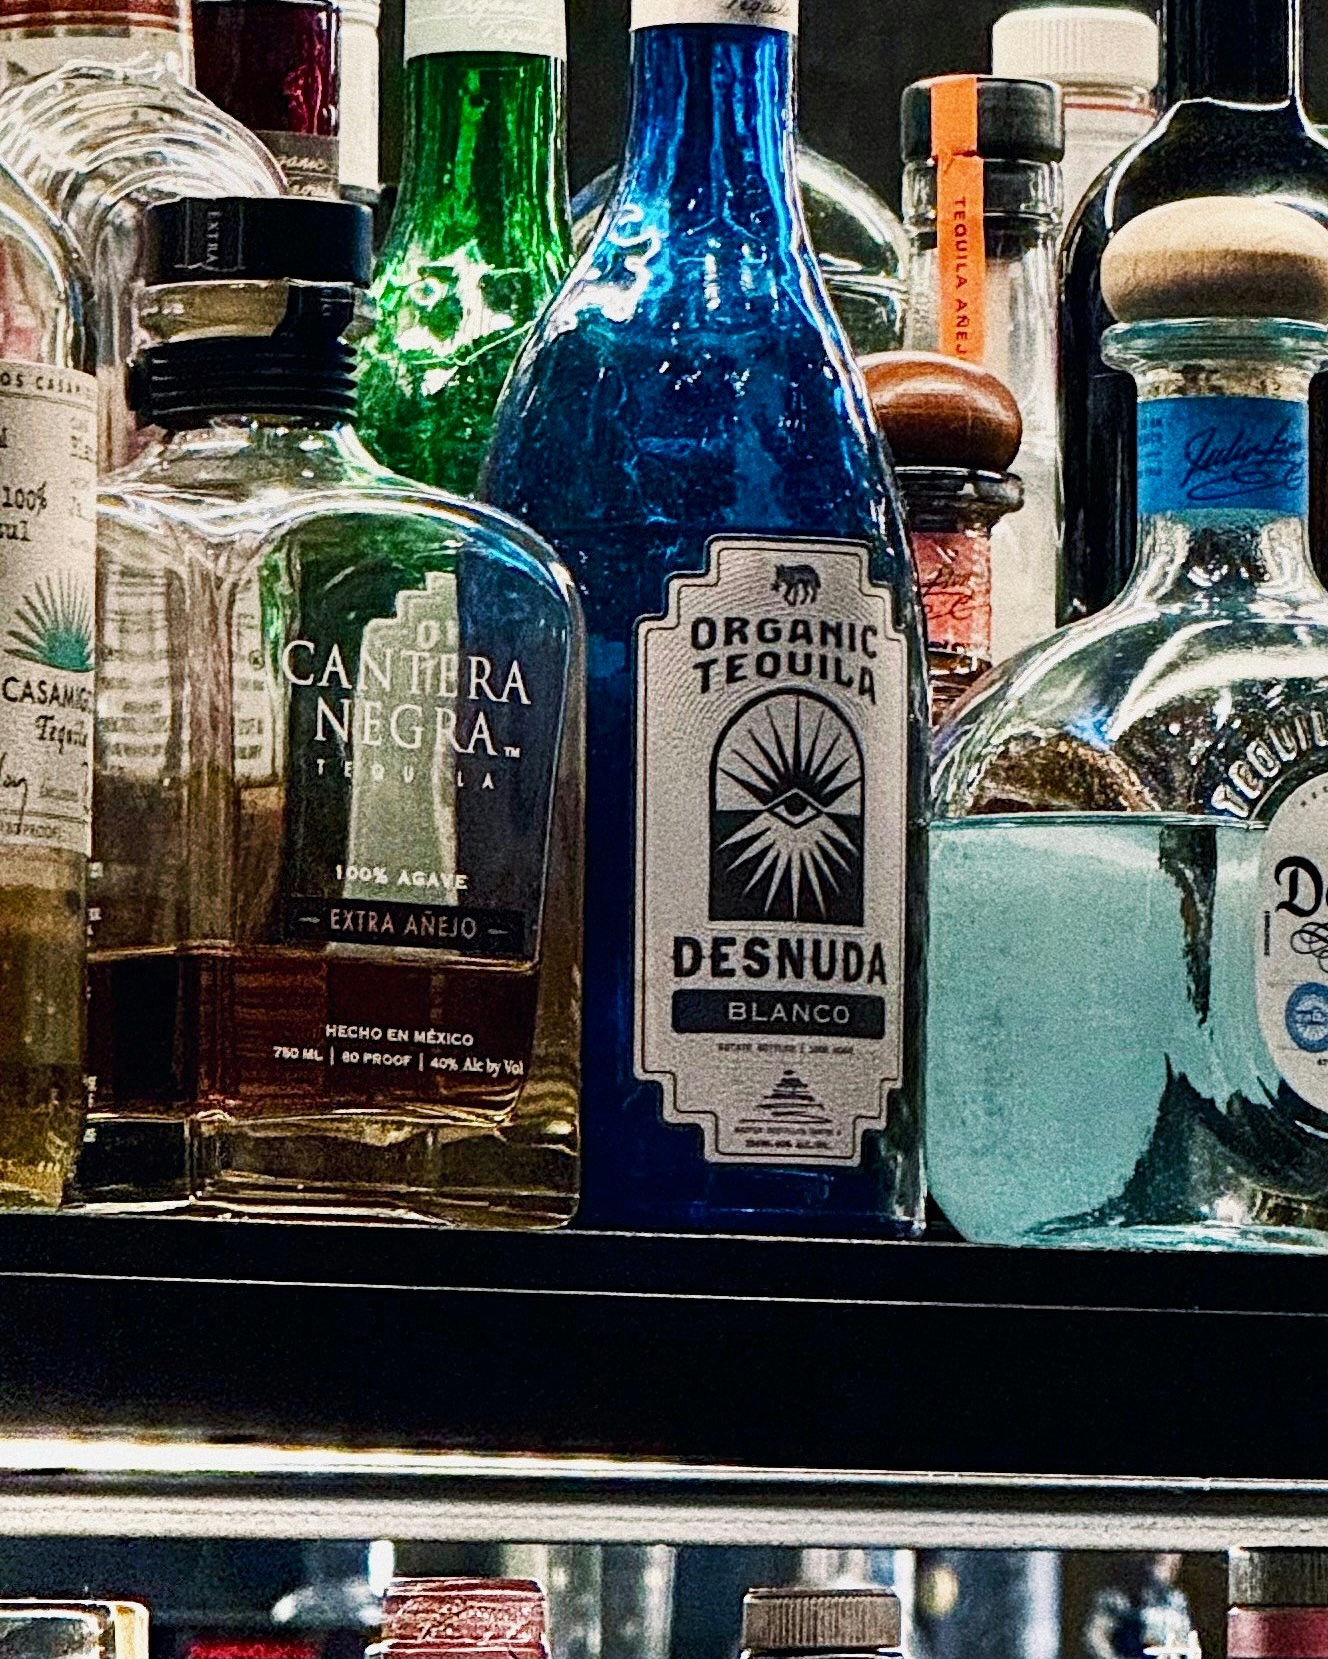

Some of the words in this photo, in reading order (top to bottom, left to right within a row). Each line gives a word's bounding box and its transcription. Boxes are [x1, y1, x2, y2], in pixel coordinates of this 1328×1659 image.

[206, 210, 222, 264] EXTRA
[953, 196, 969, 290] TEQUILA
[955, 298, 971, 356] AÑEJ
[1, 481, 49, 518] 100%
[690, 616, 878, 659] ORGANIC
[280, 640, 533, 707] CANTERA
[692, 651, 877, 705] TEQUILA
[313, 696, 500, 758] NEGRA
[315, 758, 496, 791] TEQULA
[336, 864, 388, 885] 100%
[396, 870, 470, 891] AGAVE
[329, 908, 396, 936] EXTRA
[402, 911, 478, 940] AÑEJO
[672, 936, 888, 986] DESNUDA
[727, 1001, 851, 1025] BLANCO
[325, 1023, 383, 1041] HECHO
[387, 1027, 410, 1043] EN
[413, 1026, 475, 1047] MÉXICO
[272, 1045, 300, 1060] 750
[302, 1047, 325, 1062] ML
[363, 1051, 413, 1067] PROOF
[429, 1056, 460, 1071] 40%
[462, 1057, 484, 1073] Alc
[486, 1058, 502, 1078] by
[504, 1058, 525, 1076] Vol
